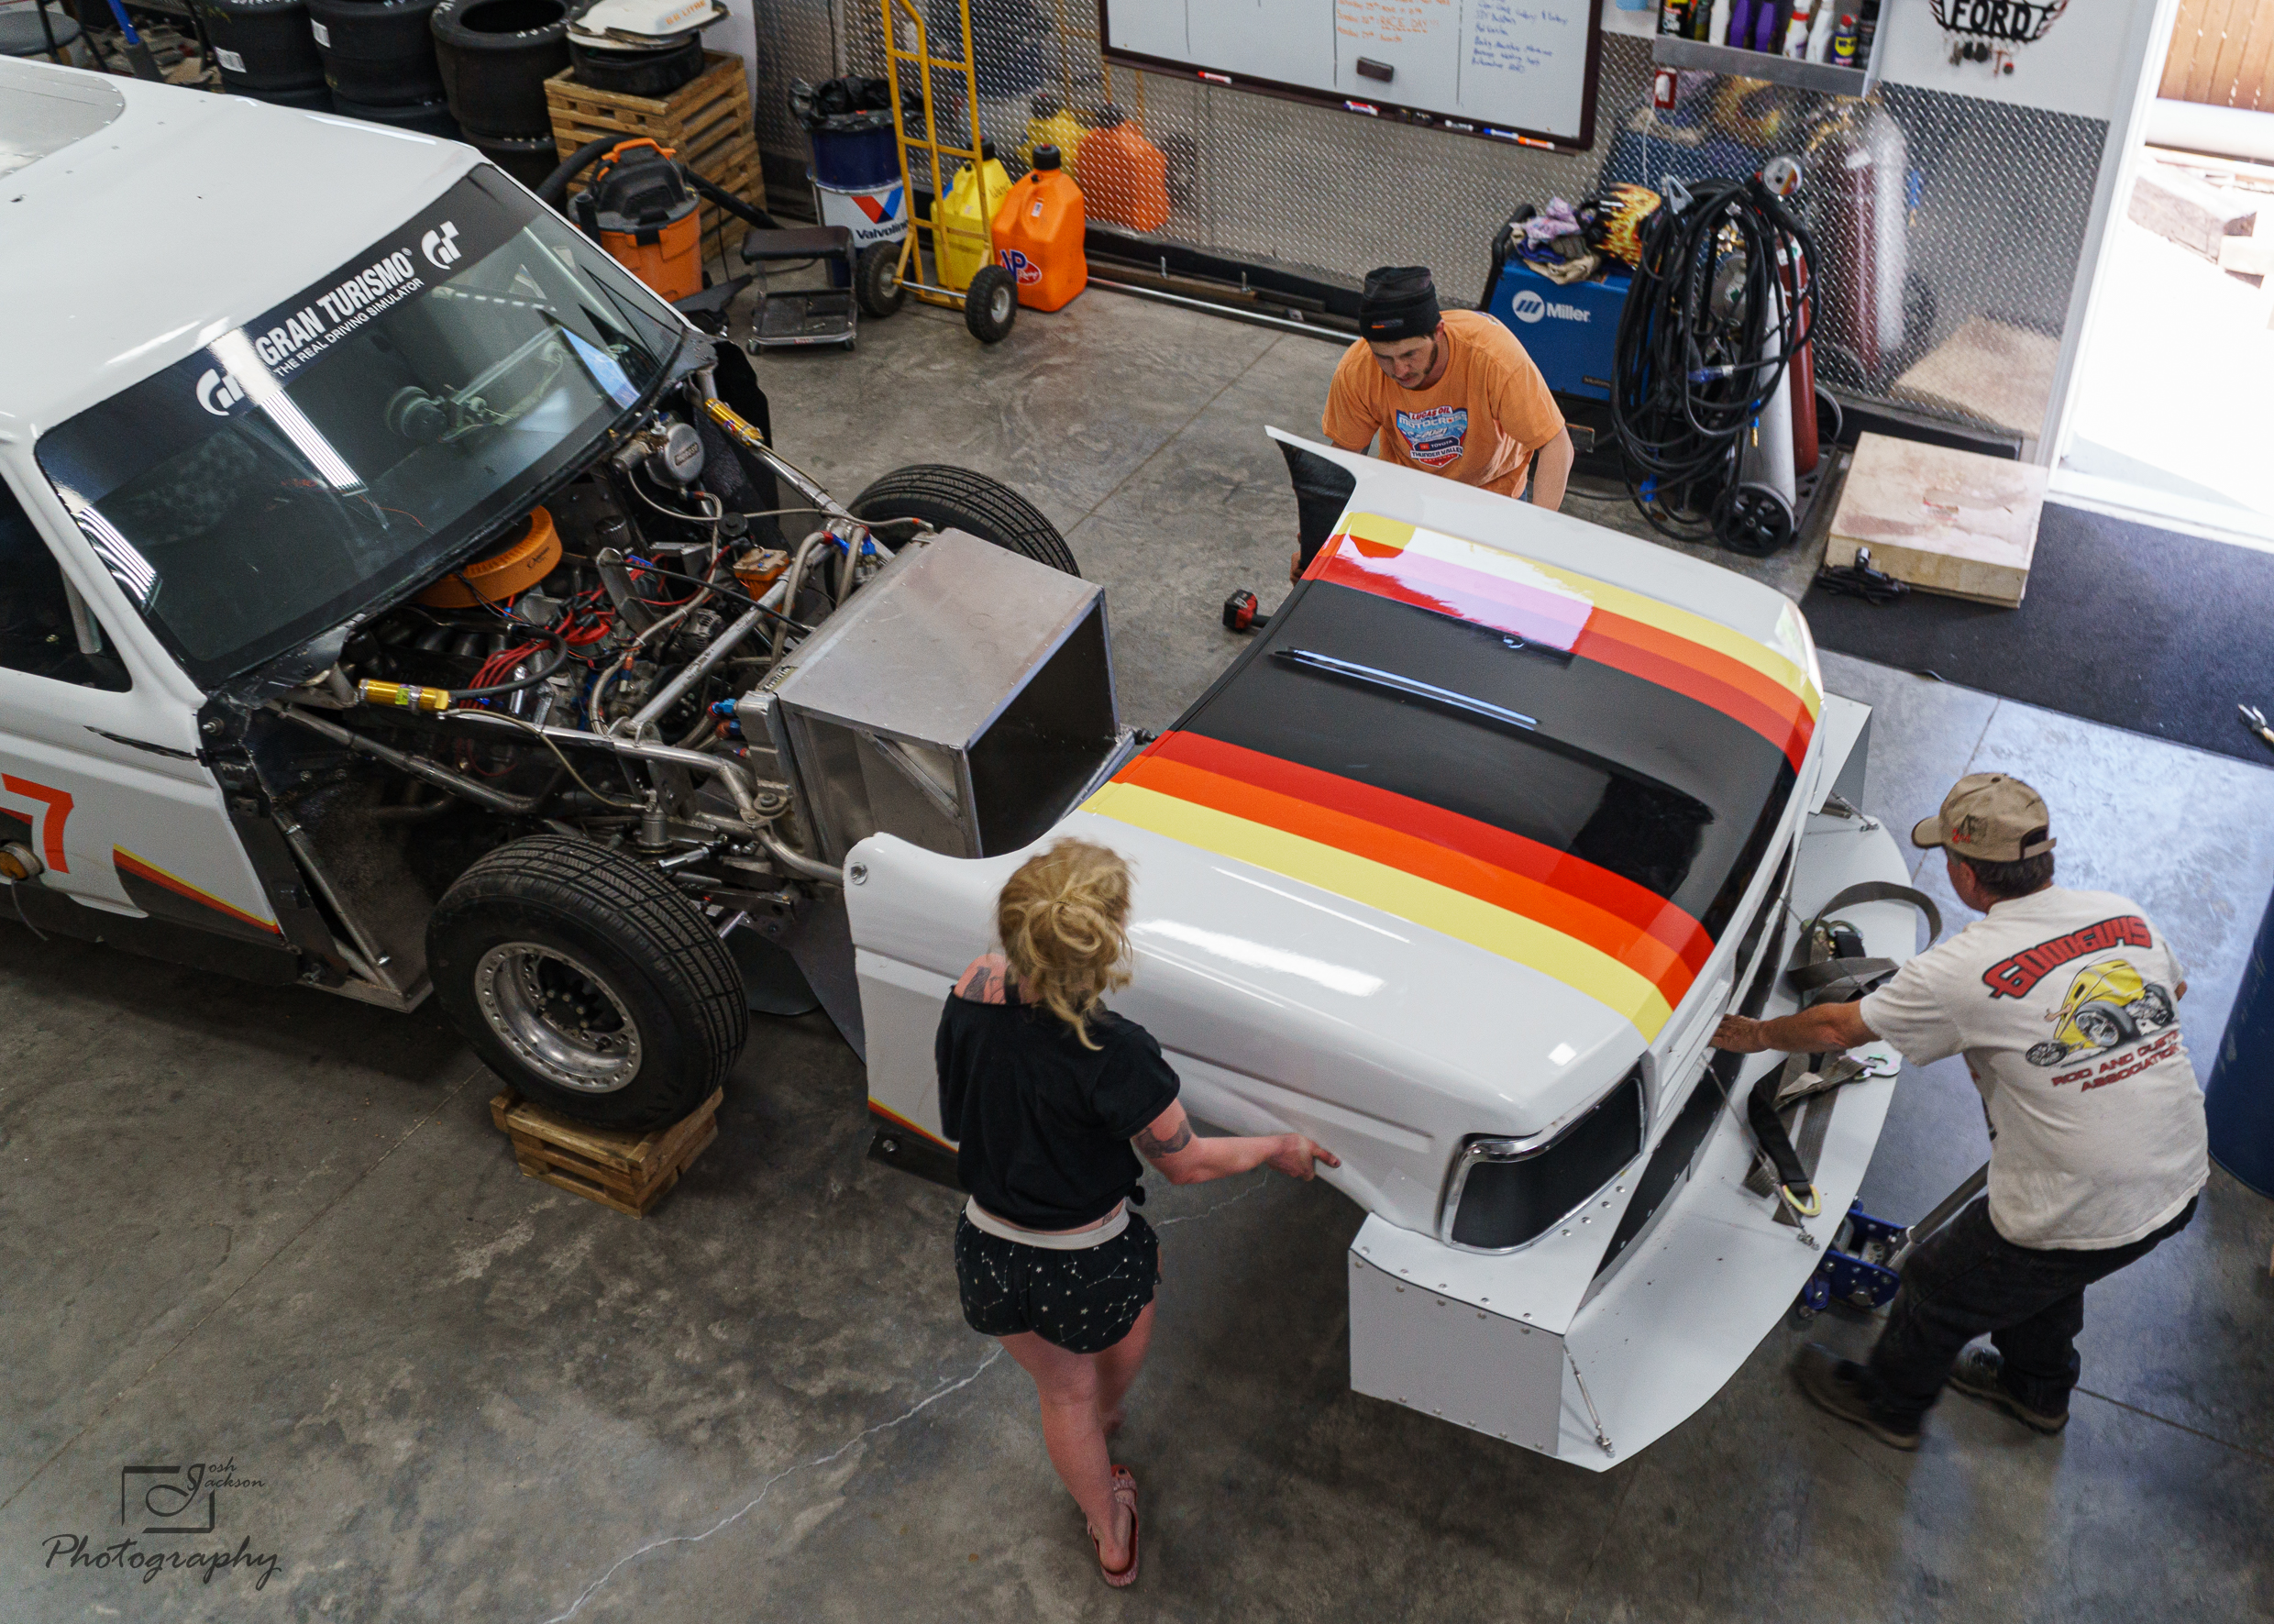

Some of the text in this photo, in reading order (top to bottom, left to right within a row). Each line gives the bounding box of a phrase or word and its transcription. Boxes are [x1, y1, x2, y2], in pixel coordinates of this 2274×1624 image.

[1950, 0, 2032, 39] FORD
[1546, 302, 1591, 322] Miller
[254, 307, 326, 367] GRAN
[273, 277, 425, 378] THE REAL DRIVING SIMULATOR
[1398, 413, 1467, 429] MOTOCROSS
[1411, 410, 1437, 420] LUCAS
[1430, 440, 1453, 448] TOYOTA
[1441, 447, 1463, 455] VALLEY
[0, 772, 75, 875] 7
[2050, 1066, 2093, 1088] ROD
[2098, 1051, 2135, 1074] AND
